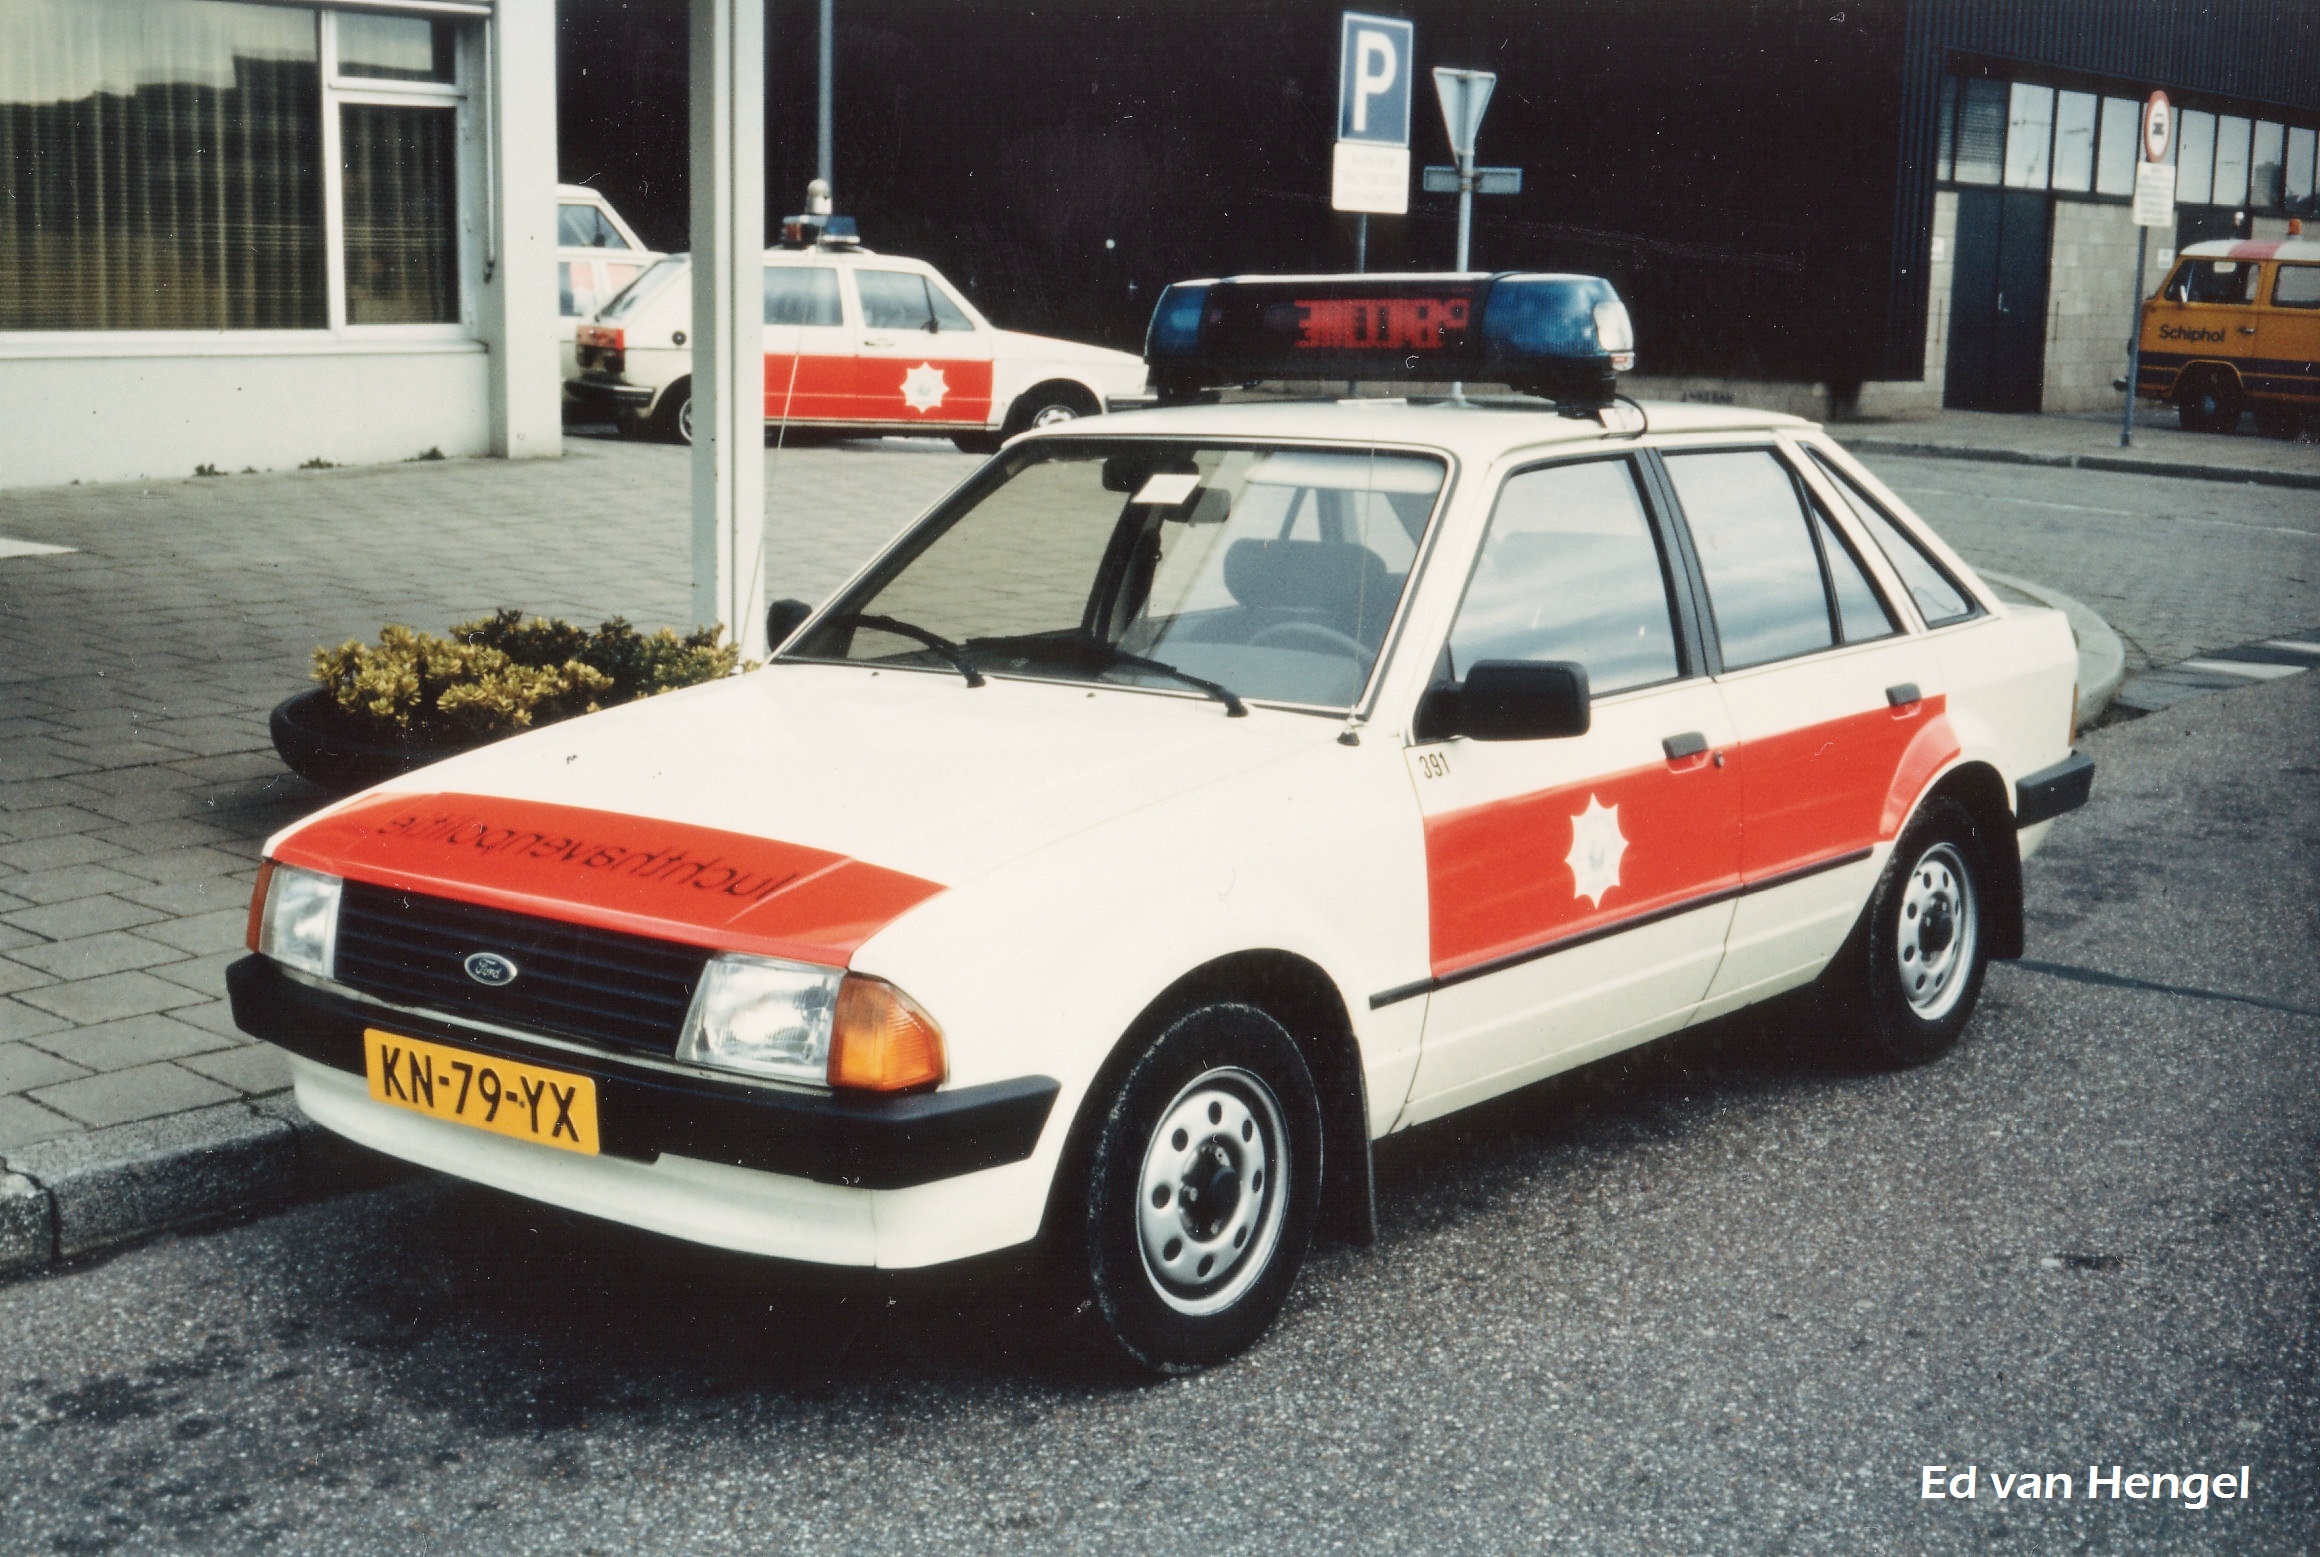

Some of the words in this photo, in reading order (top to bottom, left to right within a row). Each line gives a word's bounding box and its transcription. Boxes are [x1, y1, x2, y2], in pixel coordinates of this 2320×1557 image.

[1353, 30, 1397, 132] P
[2159, 323, 2226, 344] Schiphol
[1419, 751, 1450, 779] 391
[475, 958, 503, 979] Ford
[381, 1044, 580, 1143] KN-79-YX
